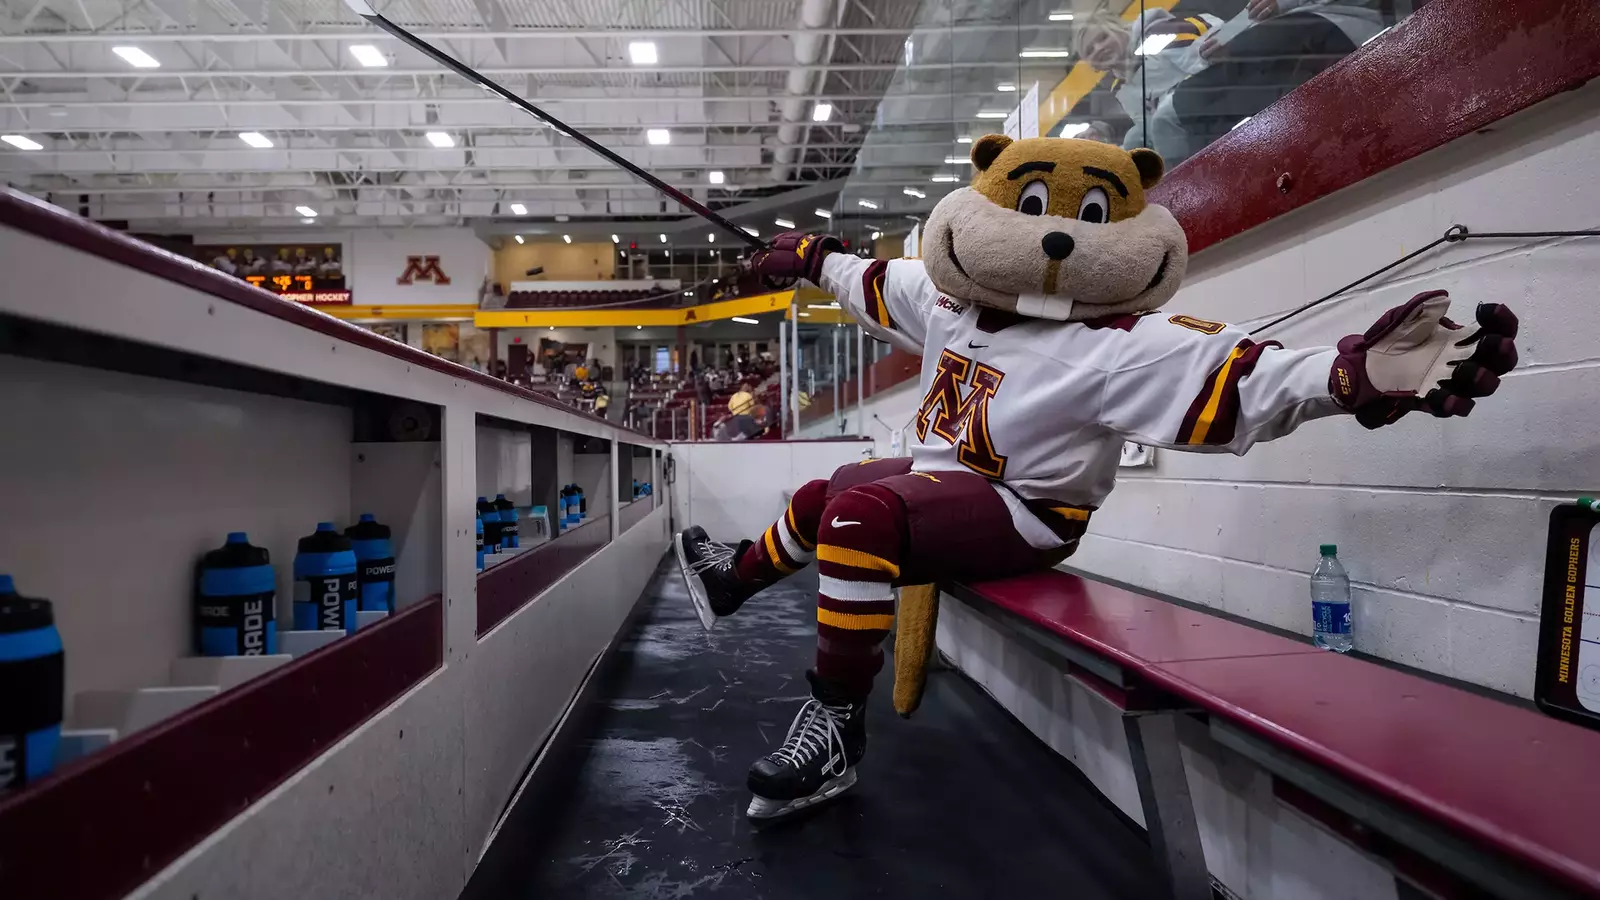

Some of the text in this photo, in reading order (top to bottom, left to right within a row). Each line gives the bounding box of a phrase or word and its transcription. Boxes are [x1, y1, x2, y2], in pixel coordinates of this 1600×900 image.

[397, 255, 451, 285] M
[315, 293, 349, 302] HOCKEY
[769, 296, 776, 306] 2
[935, 295, 965, 315] WCHA
[1337, 367, 1349, 395] CCM
[915, 347, 1008, 481] M
[1558, 537, 1580, 684] MINNESOTA GOLDEN GOPHERS
